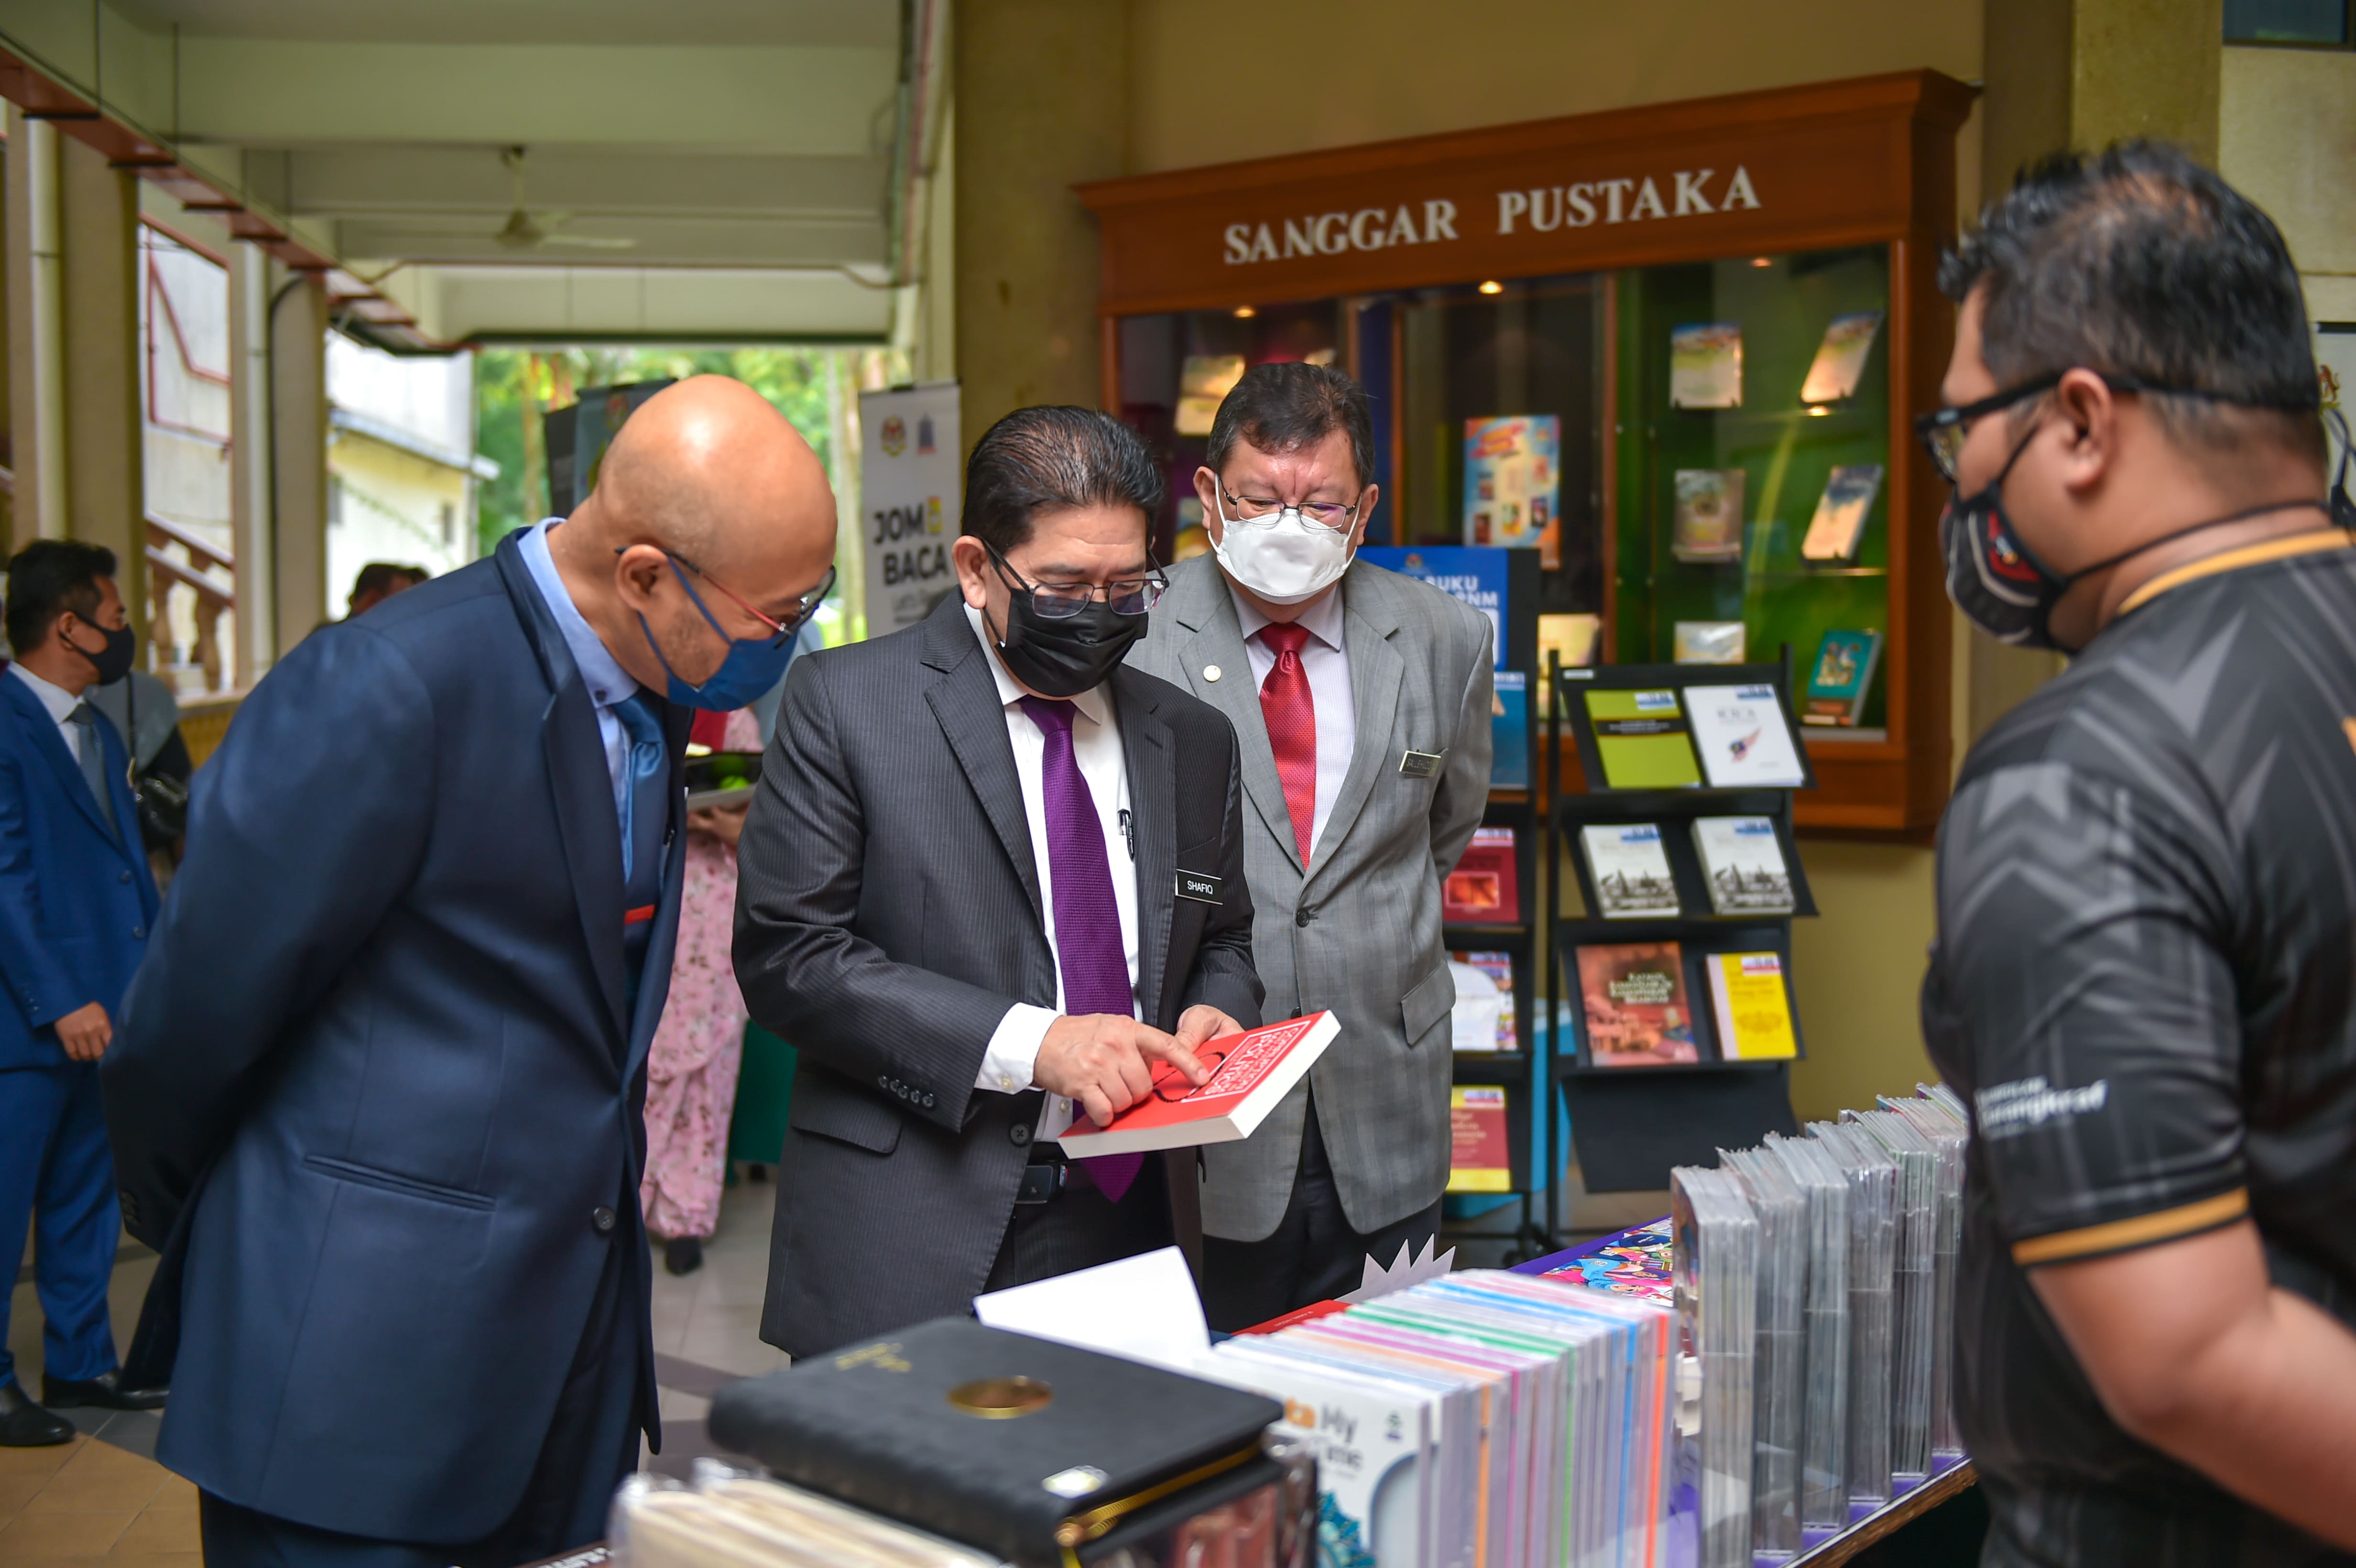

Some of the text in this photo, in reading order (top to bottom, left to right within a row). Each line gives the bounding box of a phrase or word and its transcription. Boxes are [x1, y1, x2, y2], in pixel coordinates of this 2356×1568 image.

[1224, 165, 1762, 264] SANGGAR PUSTAKA
[873, 502, 924, 546] JOM
[883, 543, 949, 586] BACA
[1187, 880, 1213, 895] SHAFIQ
